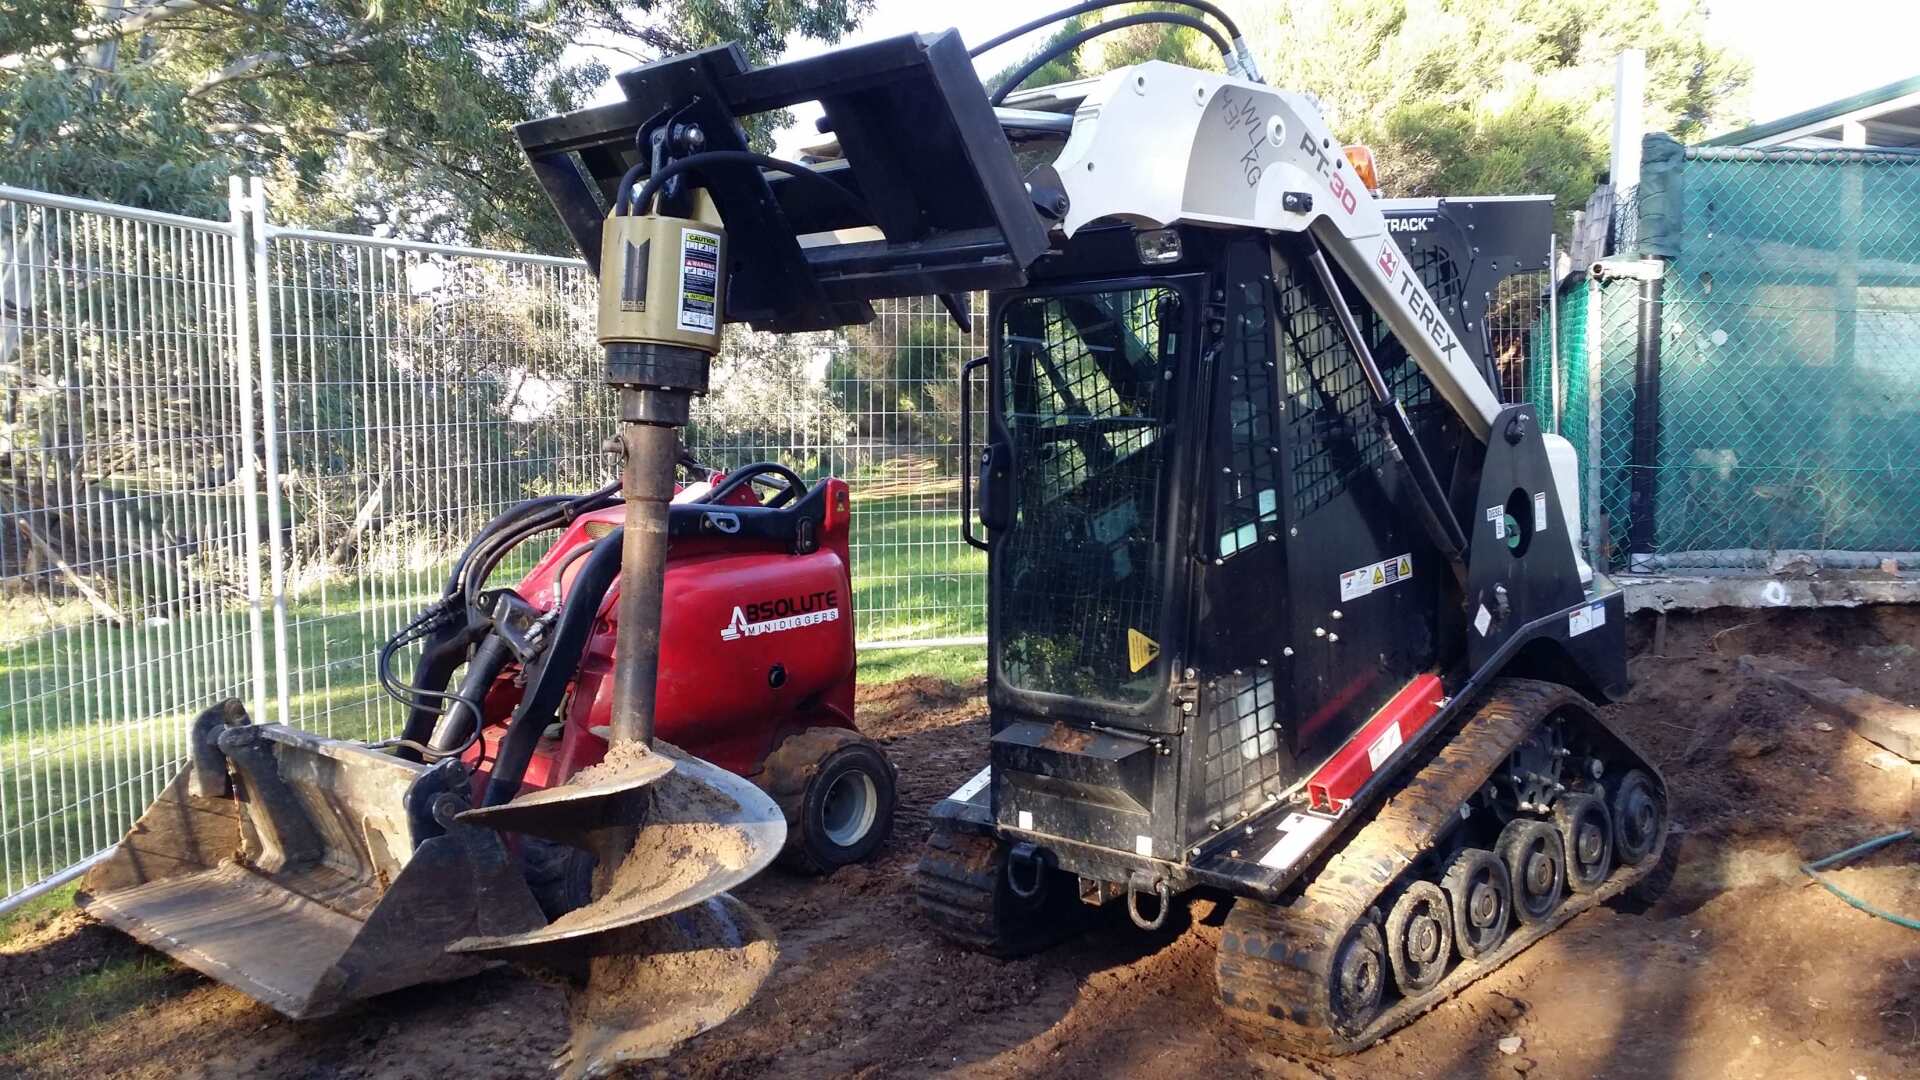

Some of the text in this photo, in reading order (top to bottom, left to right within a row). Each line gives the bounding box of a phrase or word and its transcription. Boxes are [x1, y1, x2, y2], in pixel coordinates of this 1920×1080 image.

[1299, 131, 1357, 216] PT-30
[689, 235, 716, 245] CAUTION
[1399, 270, 1458, 363] TEREX
[747, 610, 837, 635] MINIDIGGERS
